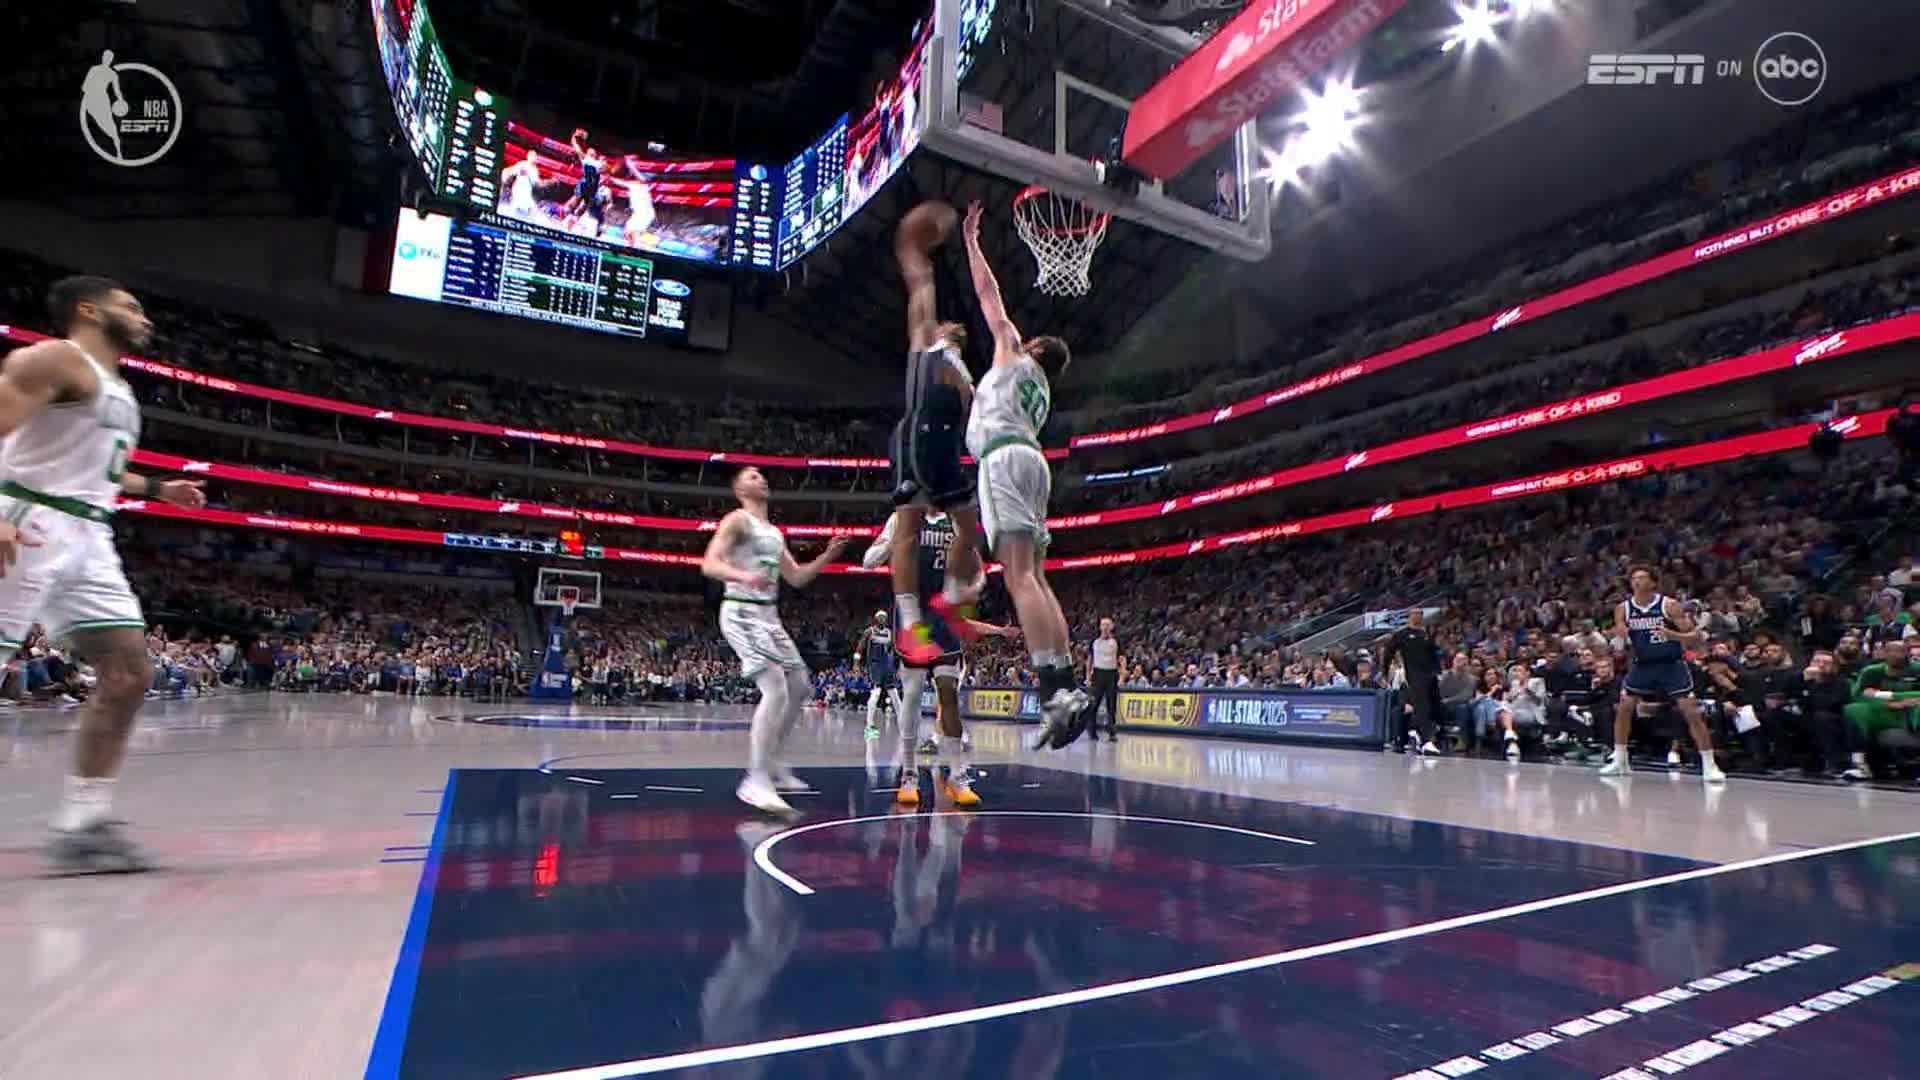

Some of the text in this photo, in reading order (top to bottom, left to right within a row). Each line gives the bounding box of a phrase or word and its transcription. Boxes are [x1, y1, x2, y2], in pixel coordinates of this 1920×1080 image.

[1217, 2, 1383, 117] State Farm
[1694, 233, 1748, 258] NOTHING
[1749, 224, 1775, 241] BUT
[1217, 699, 1261, 725] ALL-STAR
[1261, 700, 1289, 726] 2025
